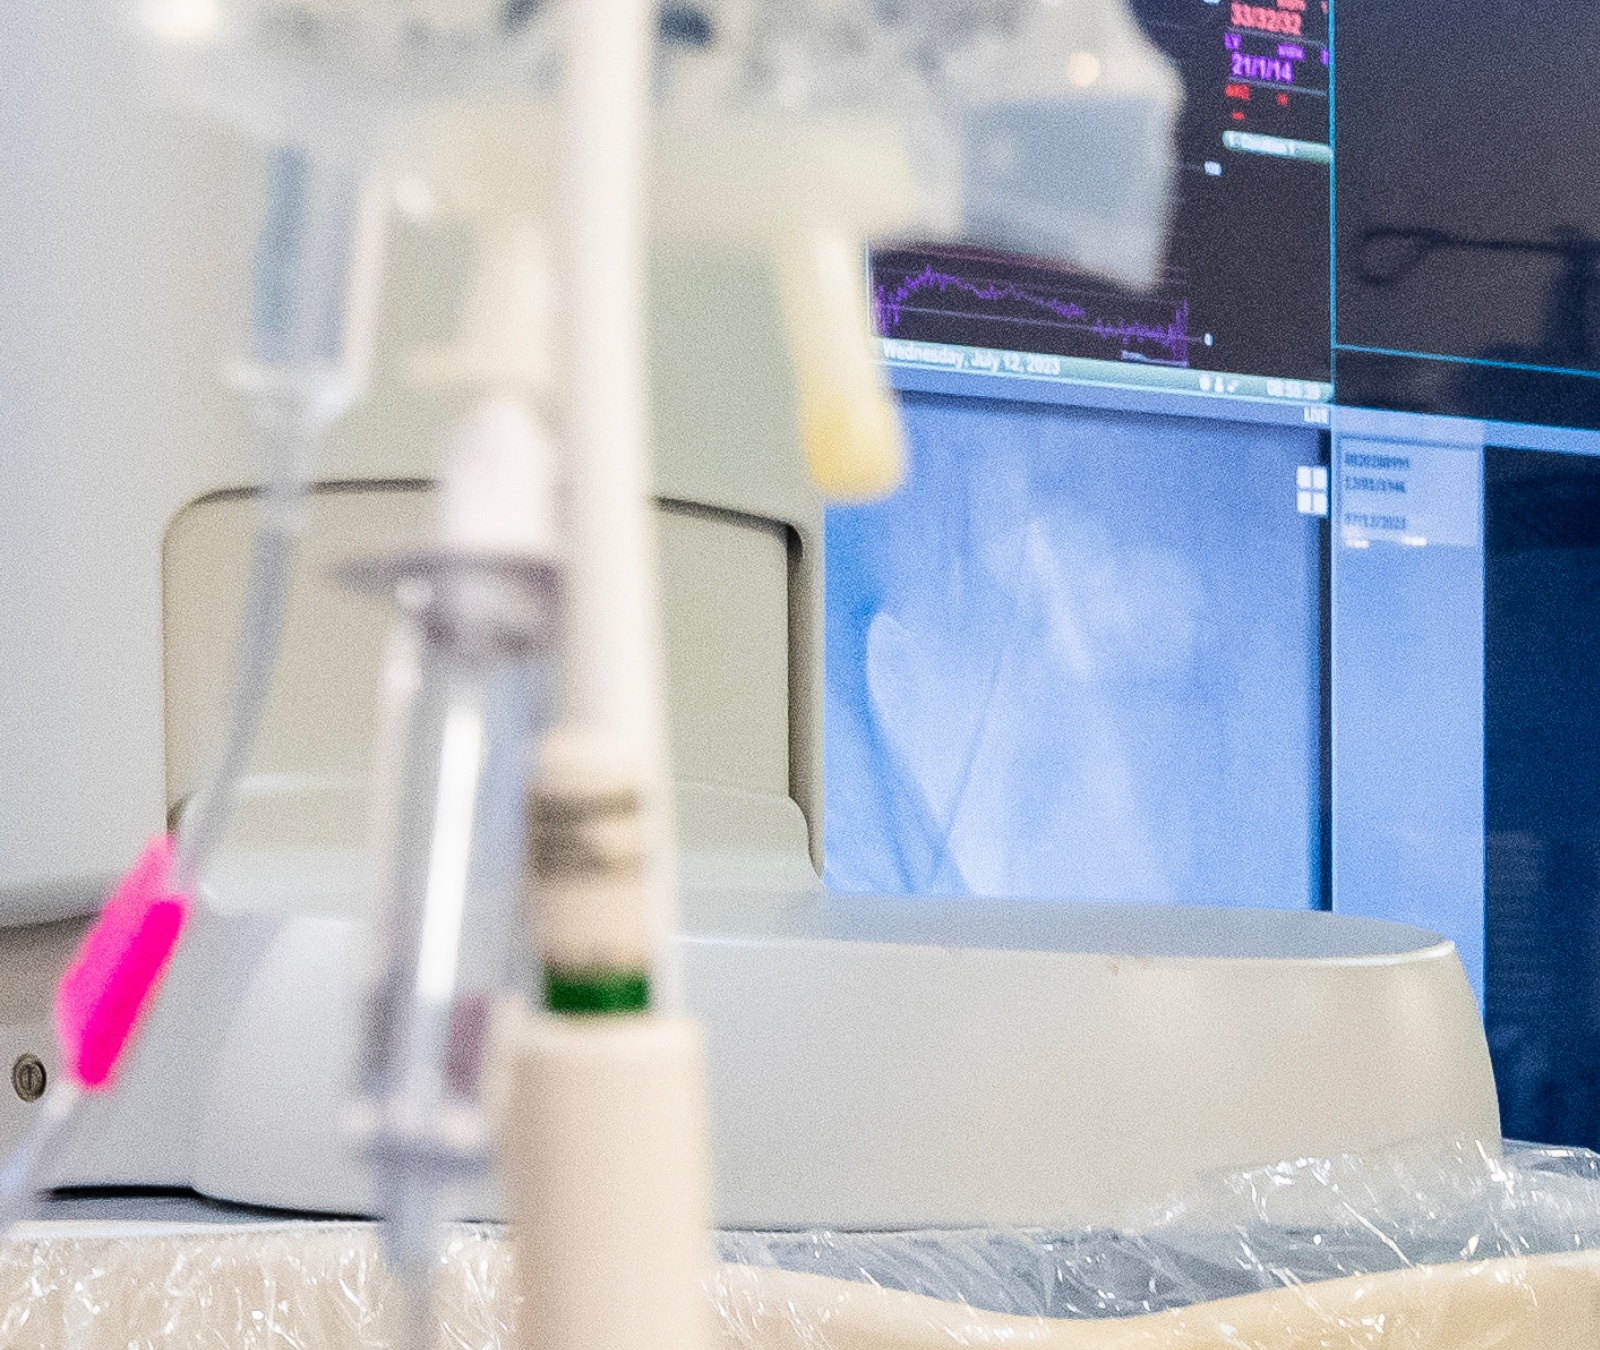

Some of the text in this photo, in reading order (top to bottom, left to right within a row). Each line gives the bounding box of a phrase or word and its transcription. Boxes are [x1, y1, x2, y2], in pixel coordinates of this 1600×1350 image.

[883, 339, 1061, 375] Wednesday, July 12, 2023
